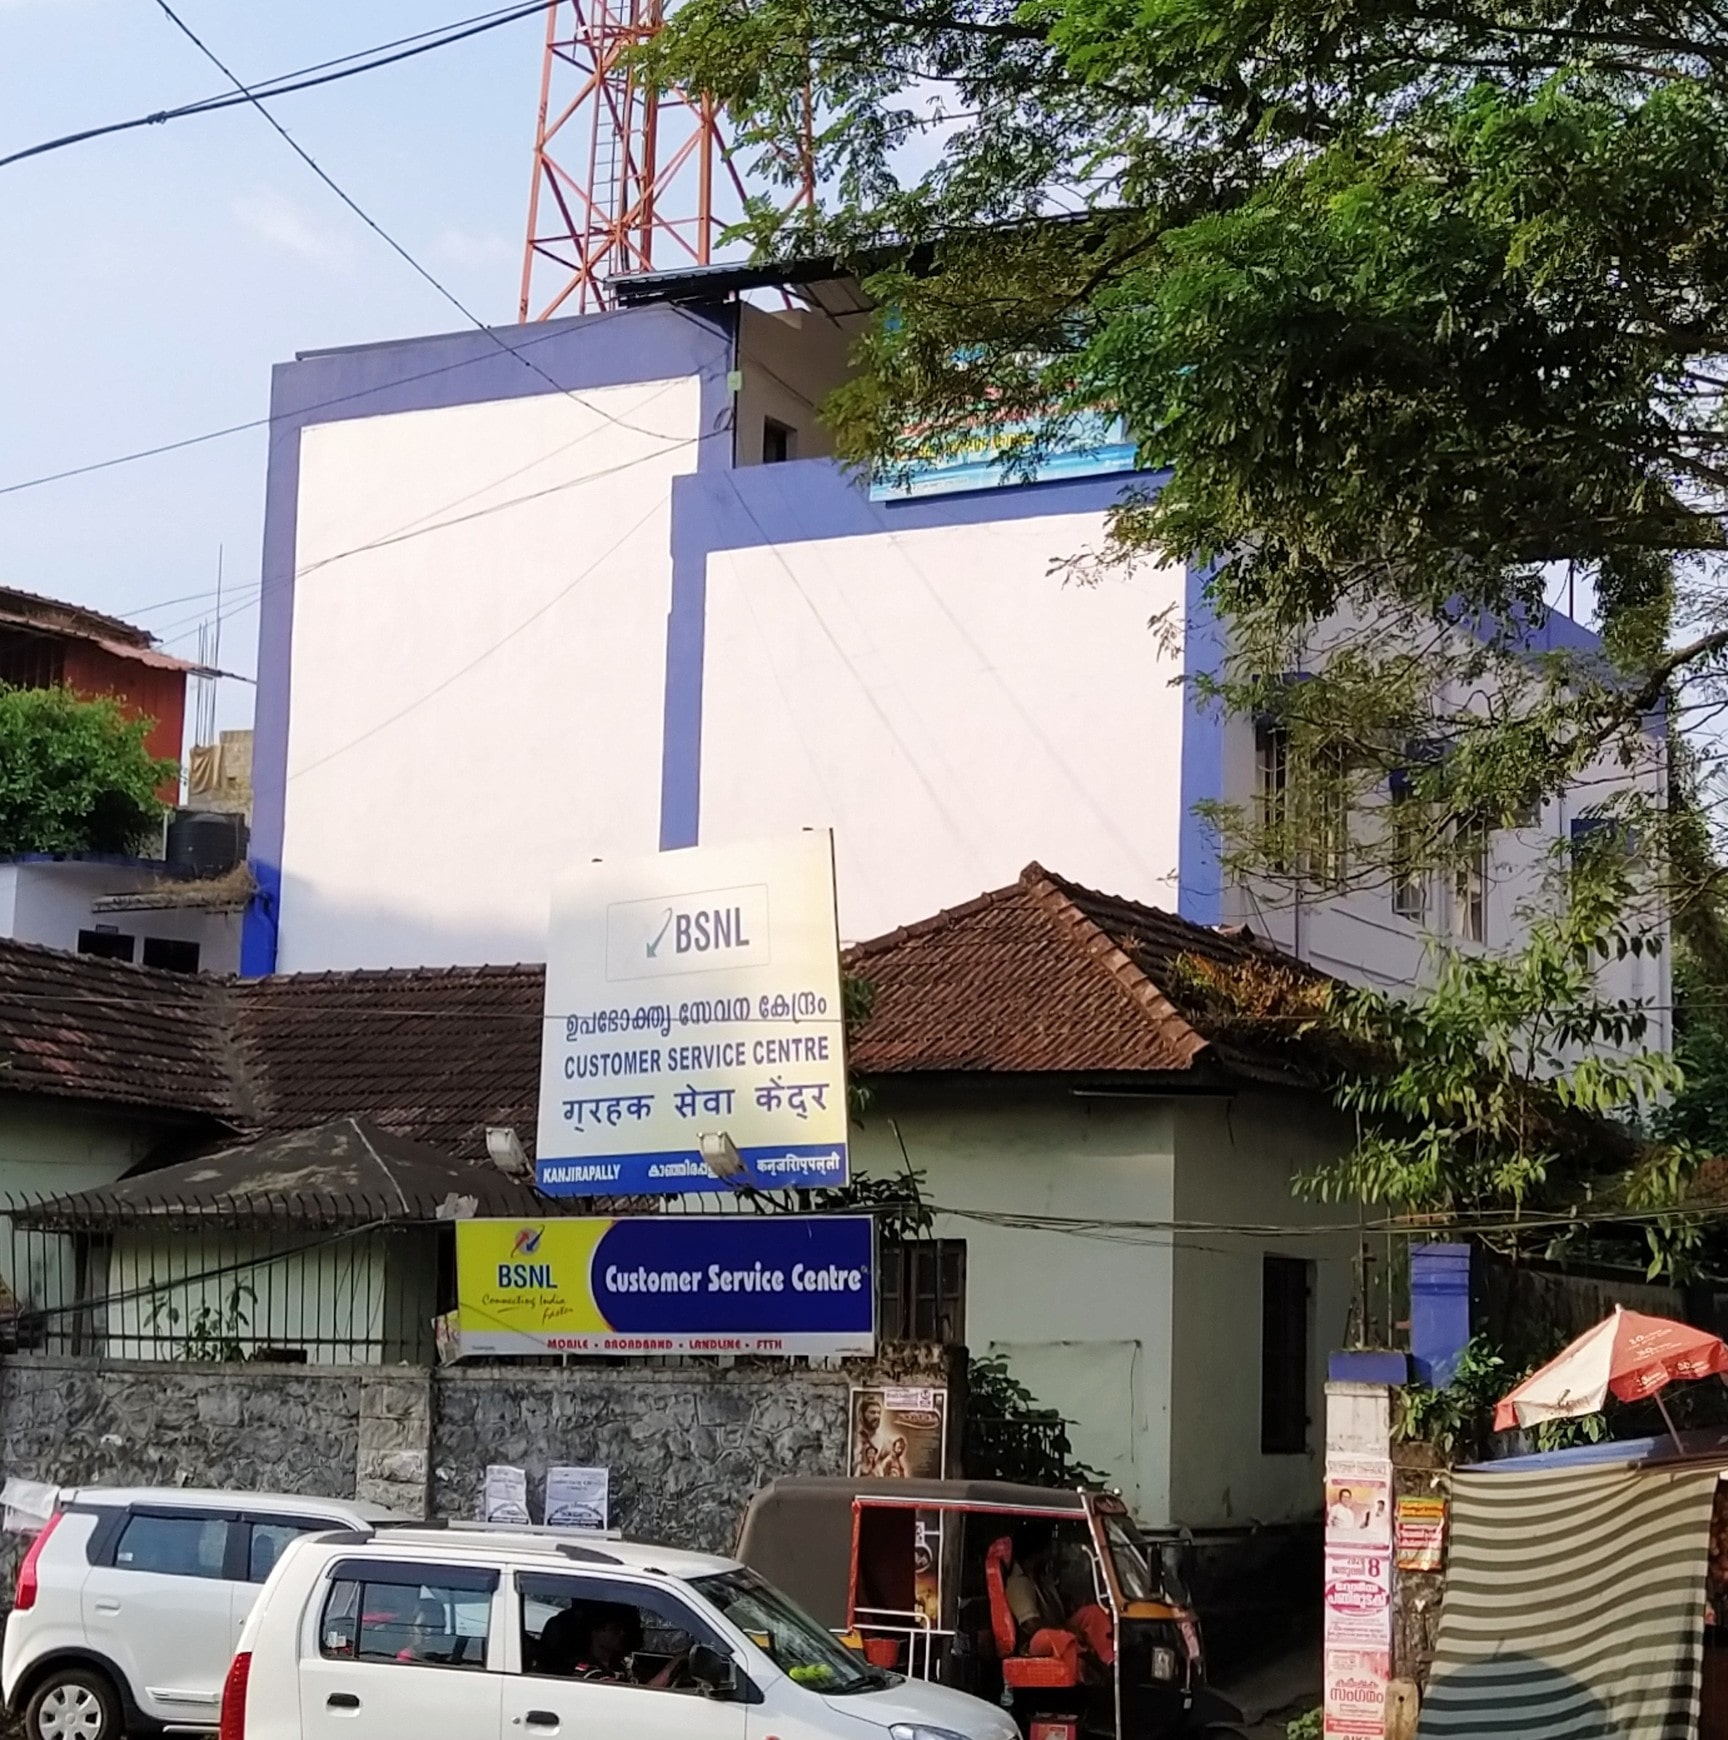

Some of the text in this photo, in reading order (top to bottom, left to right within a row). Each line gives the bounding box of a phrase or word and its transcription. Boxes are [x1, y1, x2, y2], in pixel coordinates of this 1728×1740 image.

[676, 907, 749, 953] BSNL
[679, 997, 750, 1026] സേവന
[759, 991, 827, 1023] കേന്ദ്രം
[565, 1036, 829, 1079] CUSTOMER SERVICE CENTRE
[674, 1084, 735, 1118] सेवा
[543, 1164, 621, 1184] KANJIRAPALLY
[498, 1264, 557, 1288] BSNL
[606, 1261, 861, 1292] Customer Service Centre
[540, 1294, 565, 1305] India
[547, 1339, 782, 1349] MOBILE BROADBAND LANDLINE FTTH
[1368, 1558, 1380, 1577] 8
